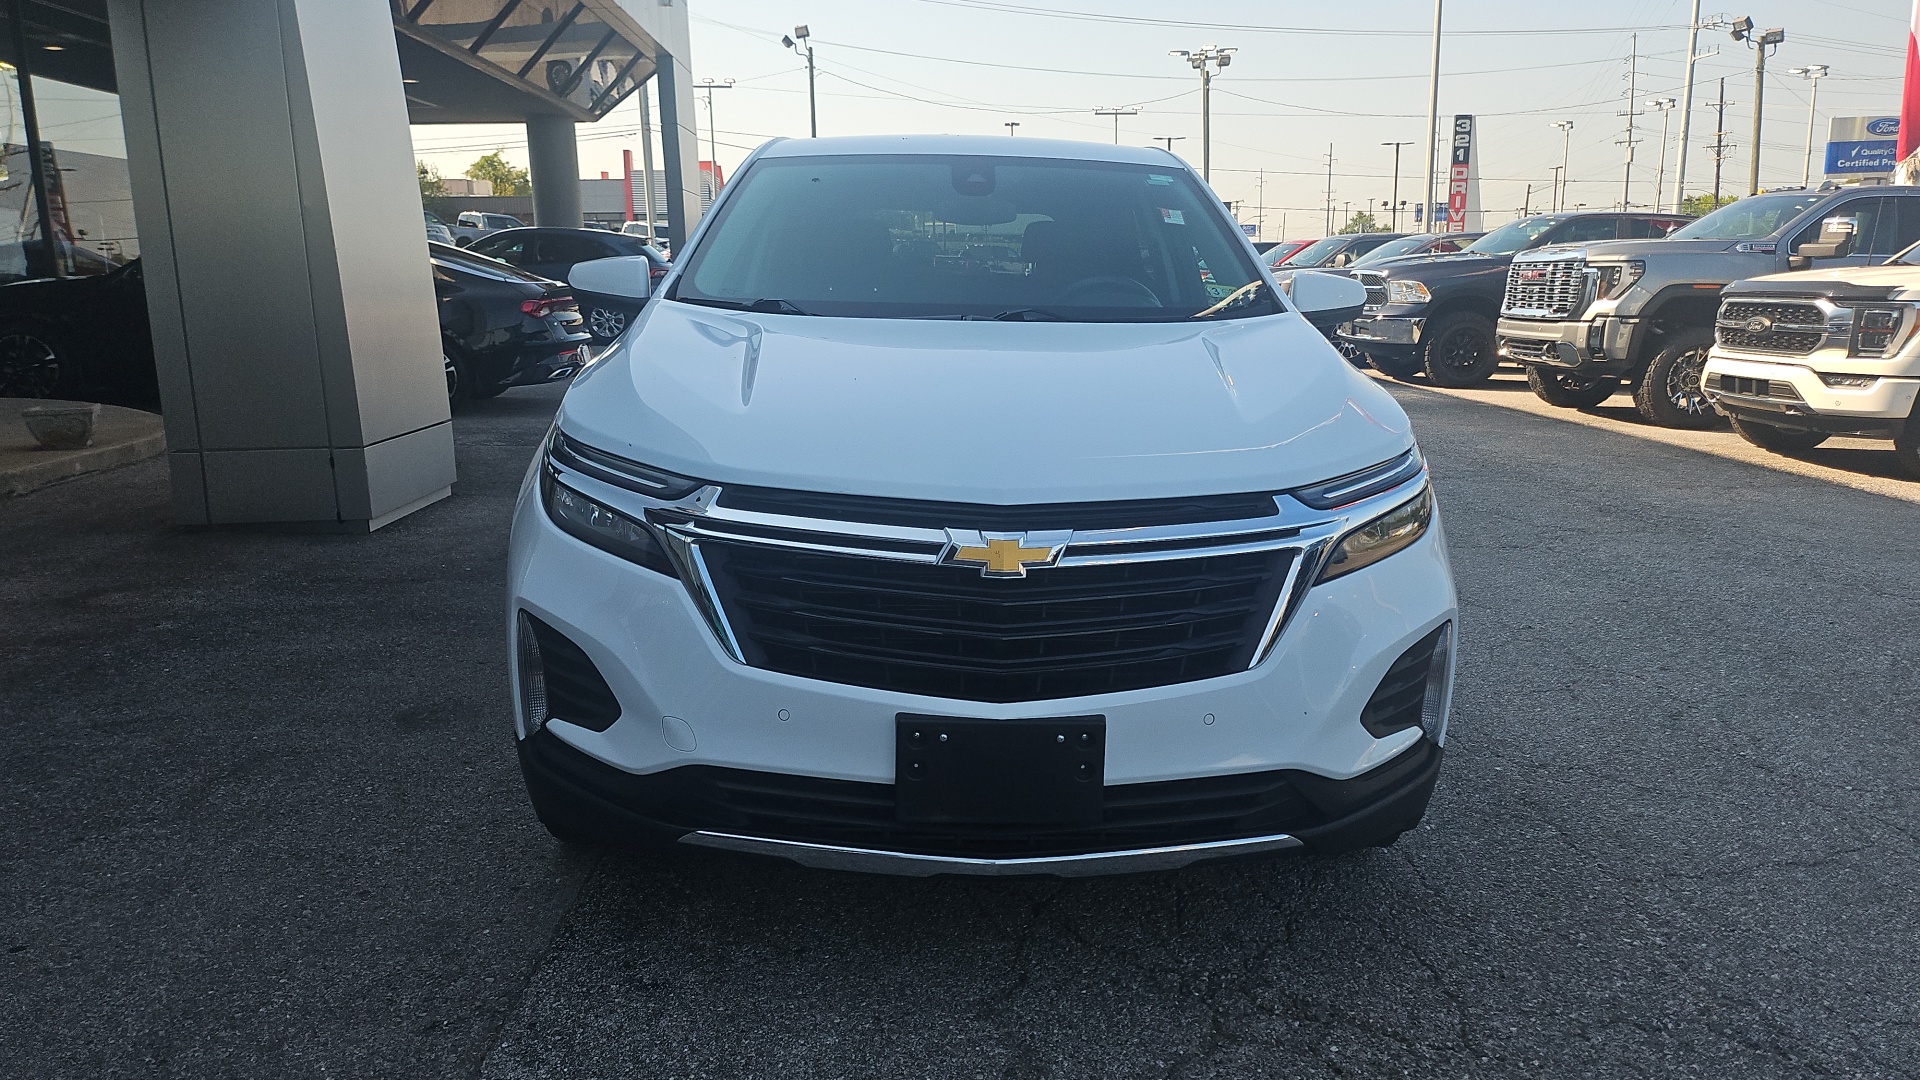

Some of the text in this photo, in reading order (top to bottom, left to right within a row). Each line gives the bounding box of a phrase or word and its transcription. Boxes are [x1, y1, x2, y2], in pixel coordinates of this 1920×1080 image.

[1876, 121, 1899, 133] Ford
[1861, 147, 1896, 156] QualityC
[1837, 158, 1879, 168] Certified
[1448, 119, 1470, 232] 321 DRIVE
